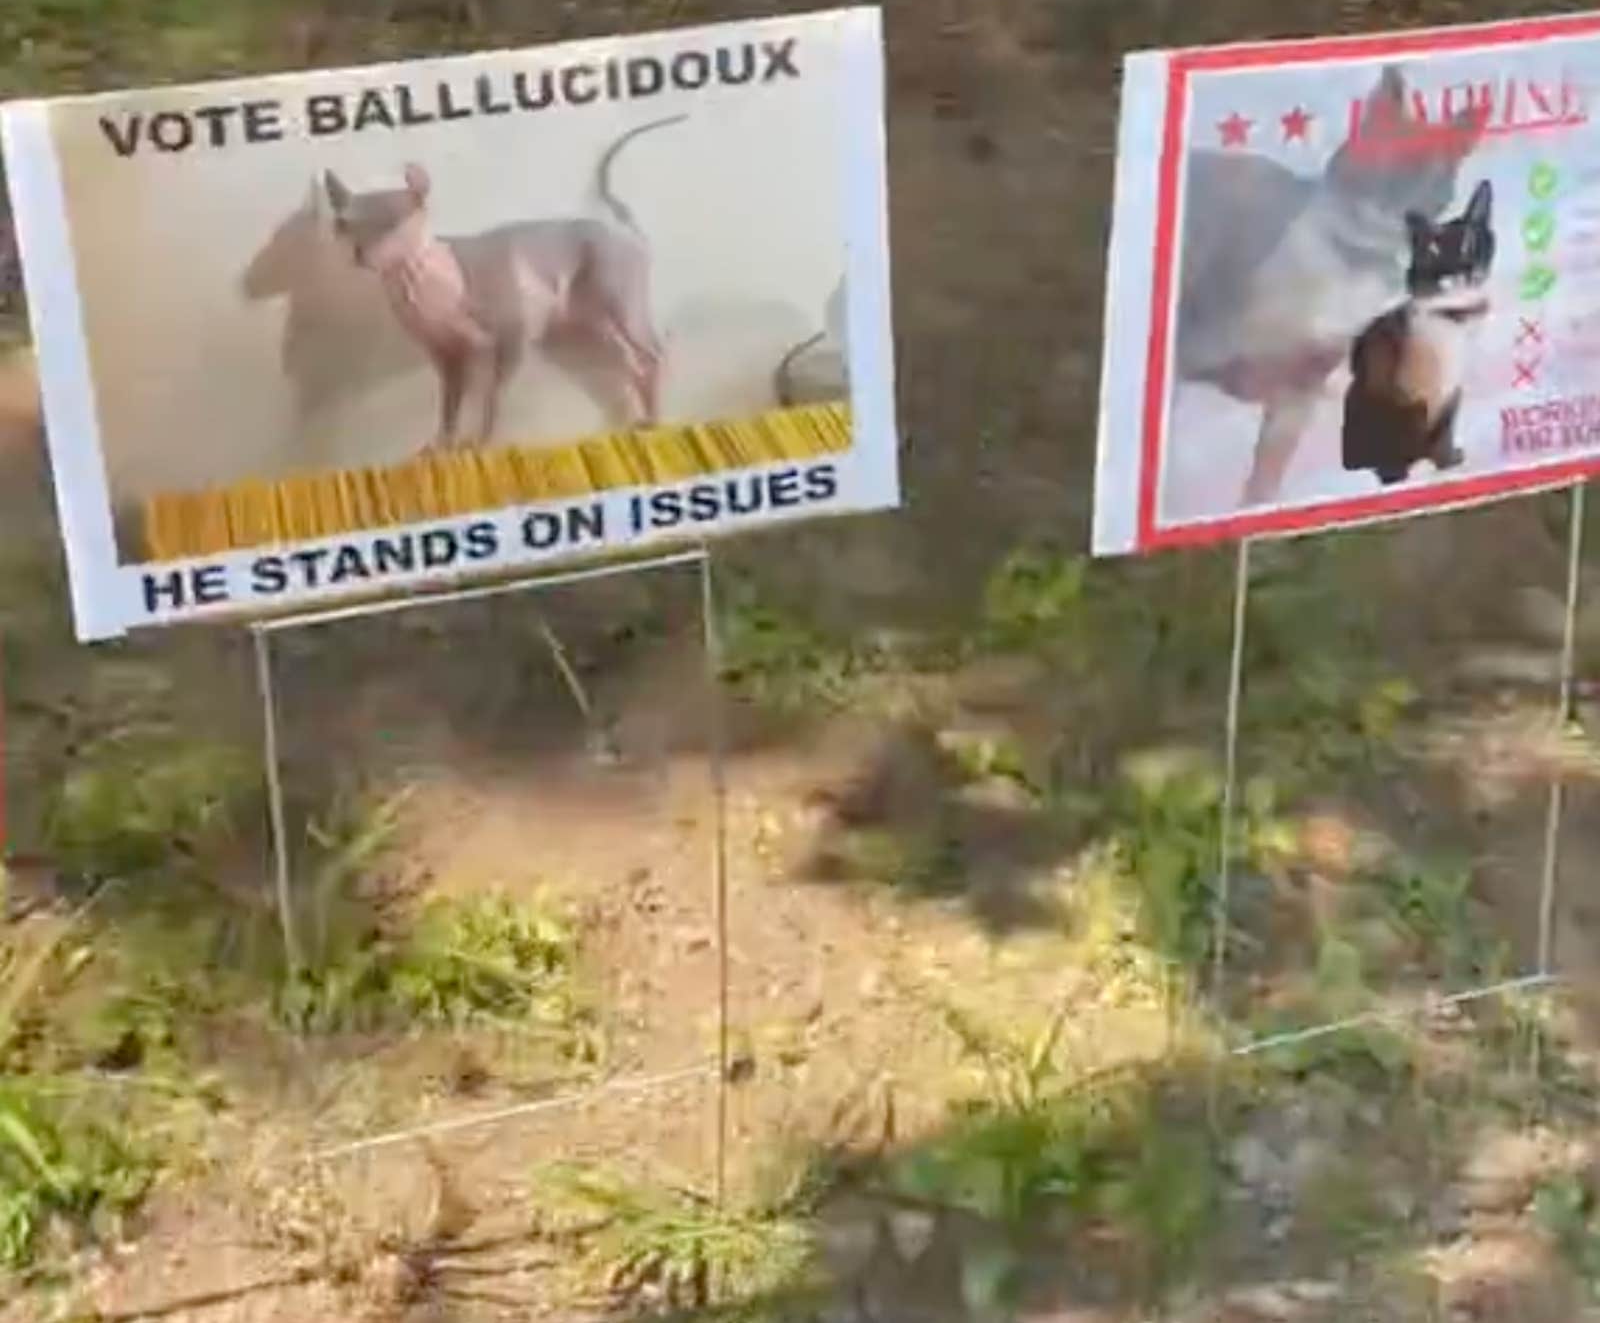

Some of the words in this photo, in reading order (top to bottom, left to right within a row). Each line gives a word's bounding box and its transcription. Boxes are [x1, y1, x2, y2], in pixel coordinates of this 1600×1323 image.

[99, 100, 283, 158] VOTE
[306, 38, 799, 136] BALLLUCIDOUX
[141, 565, 229, 613] HE
[250, 521, 498, 595] STANDS
[522, 504, 602, 549] ON
[631, 464, 838, 532] ISSUES
